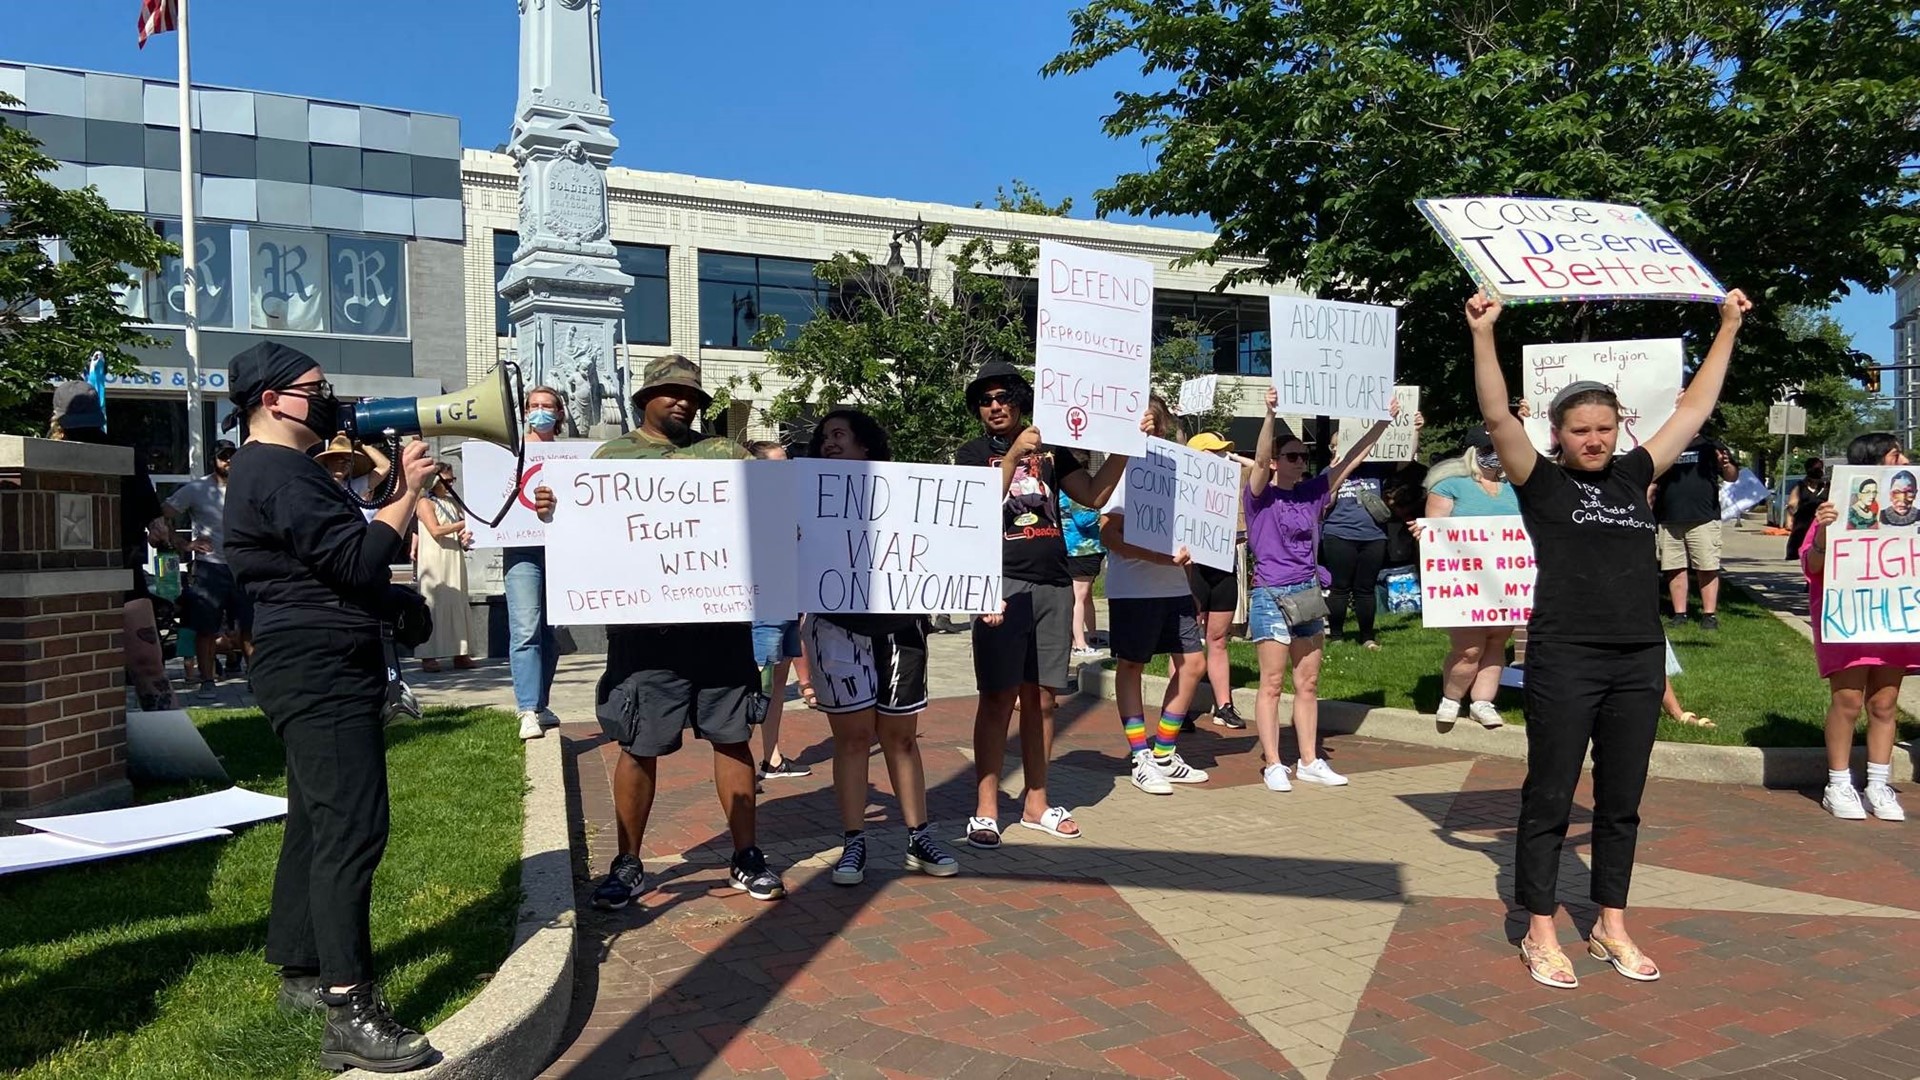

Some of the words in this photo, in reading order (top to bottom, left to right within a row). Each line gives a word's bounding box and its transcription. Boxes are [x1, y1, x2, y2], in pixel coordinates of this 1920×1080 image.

[1461, 235, 1526, 285] I
[1516, 228, 1683, 256] Deserve
[1522, 256, 1711, 290] Better!
[258, 241, 315, 319] R
[338, 248, 394, 324] R
[1050, 259, 1150, 307] DEFEND
[1040, 308, 1143, 358] REPRODUCTIVE
[1290, 304, 1390, 349] ABORTION
[1319, 347, 1345, 370] IS
[1532, 353, 1568, 377] your
[1593, 346, 1649, 371] religion
[200, 374, 225, 387] SO
[1041, 368, 1141, 413] RIGHTS
[1283, 370, 1338, 409] HEALTH
[1345, 373, 1389, 412] CARE
[1136, 440, 1177, 472] HIS
[1182, 454, 1202, 480] IS
[1206, 461, 1237, 490] OUR
[1368, 444, 1409, 459] ULLETS
[817, 474, 891, 521] END
[908, 476, 986, 529] THE
[1129, 467, 1199, 506] COUNTRY
[1205, 489, 1234, 514] NOT
[1133, 499, 1168, 537] YOUR
[1173, 514, 1234, 556] CHURCH!
[1429, 530, 1435, 543] I
[1446, 528, 1489, 543] WILL
[1502, 528, 1526, 542] HA
[660, 548, 729, 575] WIN!
[847, 530, 930, 572] WAR
[1426, 557, 1483, 572] FEWER
[1496, 555, 1538, 570] RIGH
[567, 588, 651, 611] DEFEND
[661, 584, 761, 602] REPRODUCTIVE
[703, 600, 753, 615] RIGHTS!
[819, 569, 872, 611] ON
[887, 572, 1001, 612] WOMEN
[1427, 583, 1479, 600] THAN
[1505, 583, 1532, 597] MY
[1471, 607, 1534, 622] MOTHE
